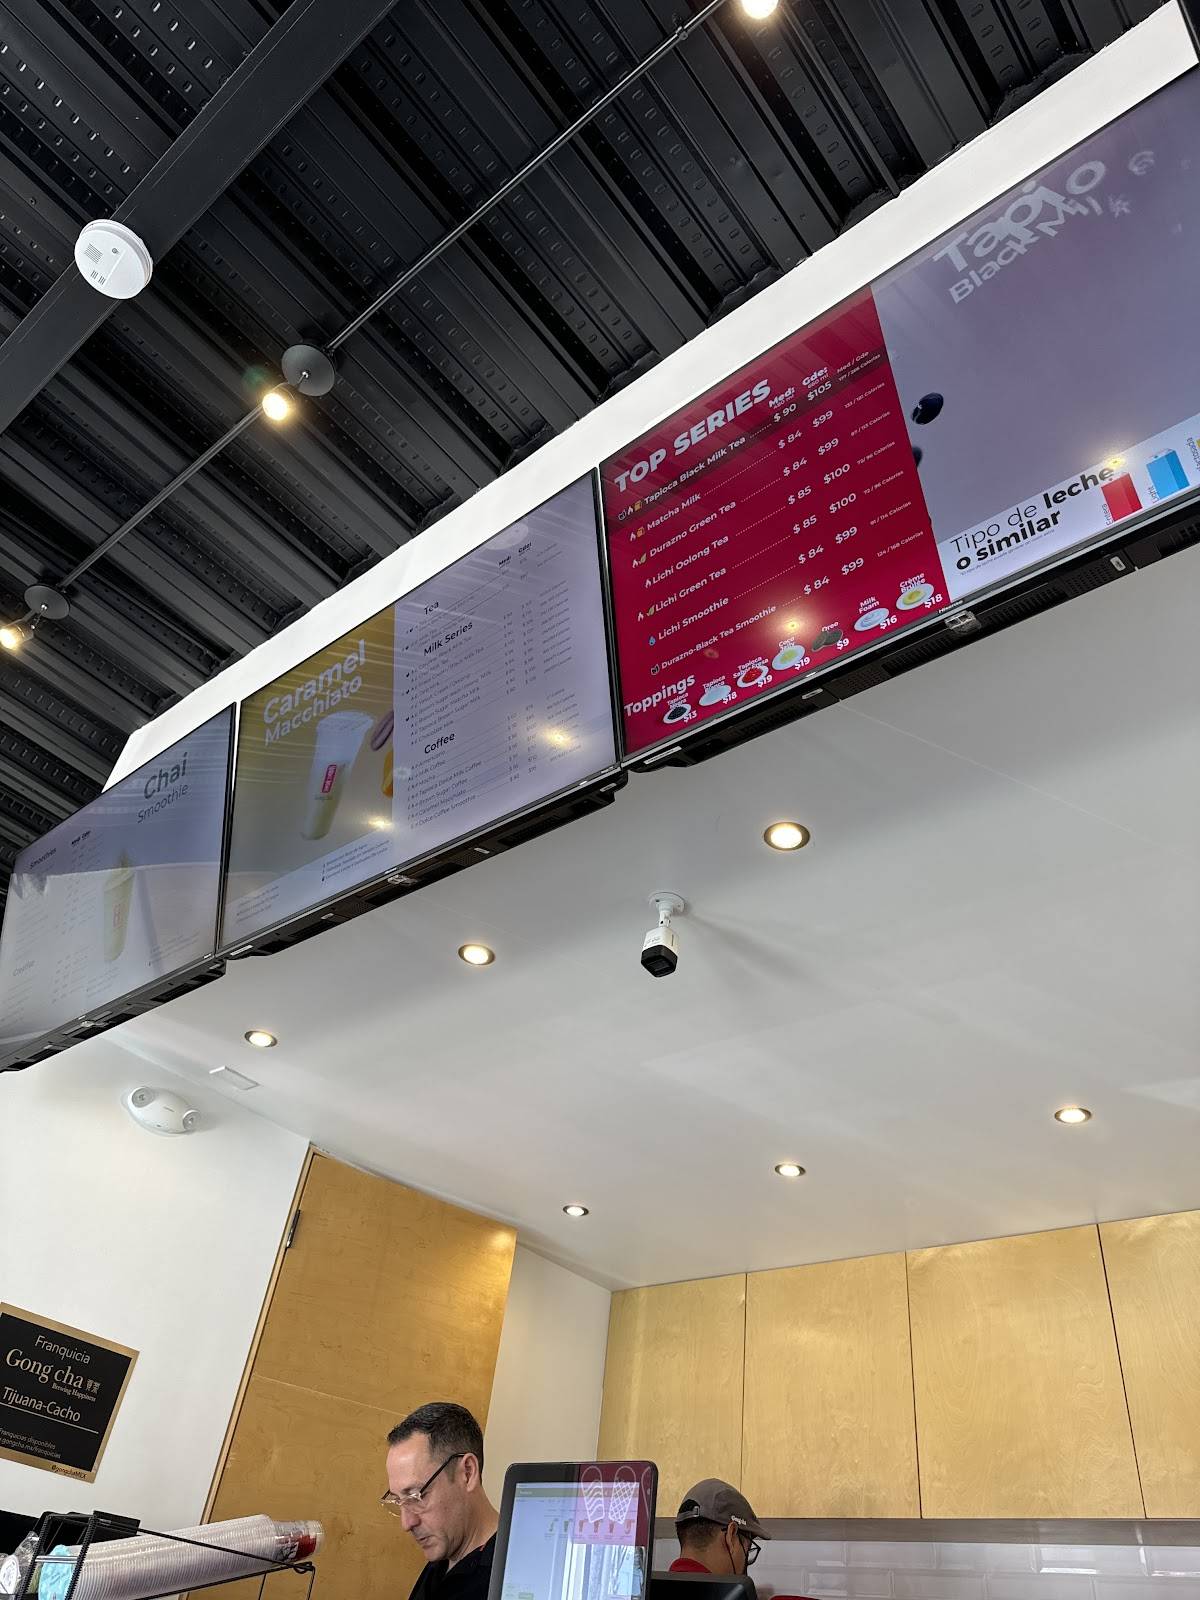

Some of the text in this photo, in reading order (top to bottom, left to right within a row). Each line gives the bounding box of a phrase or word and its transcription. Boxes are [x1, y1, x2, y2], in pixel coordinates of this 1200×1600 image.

[769, 386, 795, 407] Med:
[802, 367, 828, 386] Gde:
[614, 379, 771, 493] TOP SERIES
[644, 480, 678, 504] Tapioca
[679, 461, 705, 482] Black
[707, 448, 728, 465] Milk
[728, 437, 746, 451] Tea
[782, 404, 797, 417] 90
[807, 381, 832, 401] $105
[647, 507, 680, 531] Matcha
[681, 493, 701, 509] Milk
[787, 430, 802, 443] 84
[812, 410, 833, 428] $99
[649, 531, 687, 557] Durazno
[689, 513, 717, 533] Green
[719, 501, 736, 514] Tea
[792, 457, 807, 471] 84
[818, 438, 839, 455] $99
[950, 522, 1000, 553] Tipo
[1007, 504, 1037, 527] de
[1043, 467, 1114, 509] leche
[653, 566, 674, 584] Lichi
[676, 546, 710, 570] Oolong
[711, 536, 729, 549] Tea
[797, 486, 812, 499] 85
[823, 463, 850, 484] $100
[956, 556, 971, 570] o
[976, 510, 1061, 561] similar
[655, 593, 677, 611] Lichi
[679, 578, 707, 598] Green
[709, 568, 726, 580] Tea
[802, 515, 817, 528] 85
[829, 493, 856, 514] $100
[658, 622, 681, 640] Lichi
[682, 597, 729, 626] Smoothie
[808, 545, 824, 558] 84
[835, 527, 857, 544] $99
[860, 596, 876, 607] Milk
[924, 594, 943, 609] $18
[423, 601, 439, 615] Tea
[661, 634, 718, 669] Durazno-Black
[719, 627, 734, 639] Tea
[735, 605, 776, 630] Smoothie
[814, 575, 830, 590] 84
[841, 557, 864, 576] $99
[859, 601, 880, 614] Foam
[879, 615, 897, 630] $16
[423, 640, 443, 656] Milk
[445, 622, 473, 644] Series
[836, 638, 850, 650] $9
[263, 639, 366, 724] Caramel
[737, 656, 762, 671] Tapioca
[757, 675, 773, 687] $19
[794, 657, 810, 670] $19
[624, 674, 696, 717] Toppings
[667, 692, 689, 705] Tapioca
[702, 675, 726, 689] Tapioca
[722, 692, 738, 705] $18
[264, 675, 362, 746] Macchiato
[683, 711, 697, 723] $13
[424, 733, 455, 754] Coffee
[143, 752, 188, 800] Chai
[34, 1335, 91, 1364] Franquicia
[5, 1348, 83, 1389] Gong cha
[2, 1386, 81, 1422] Tijuana-Cacho
